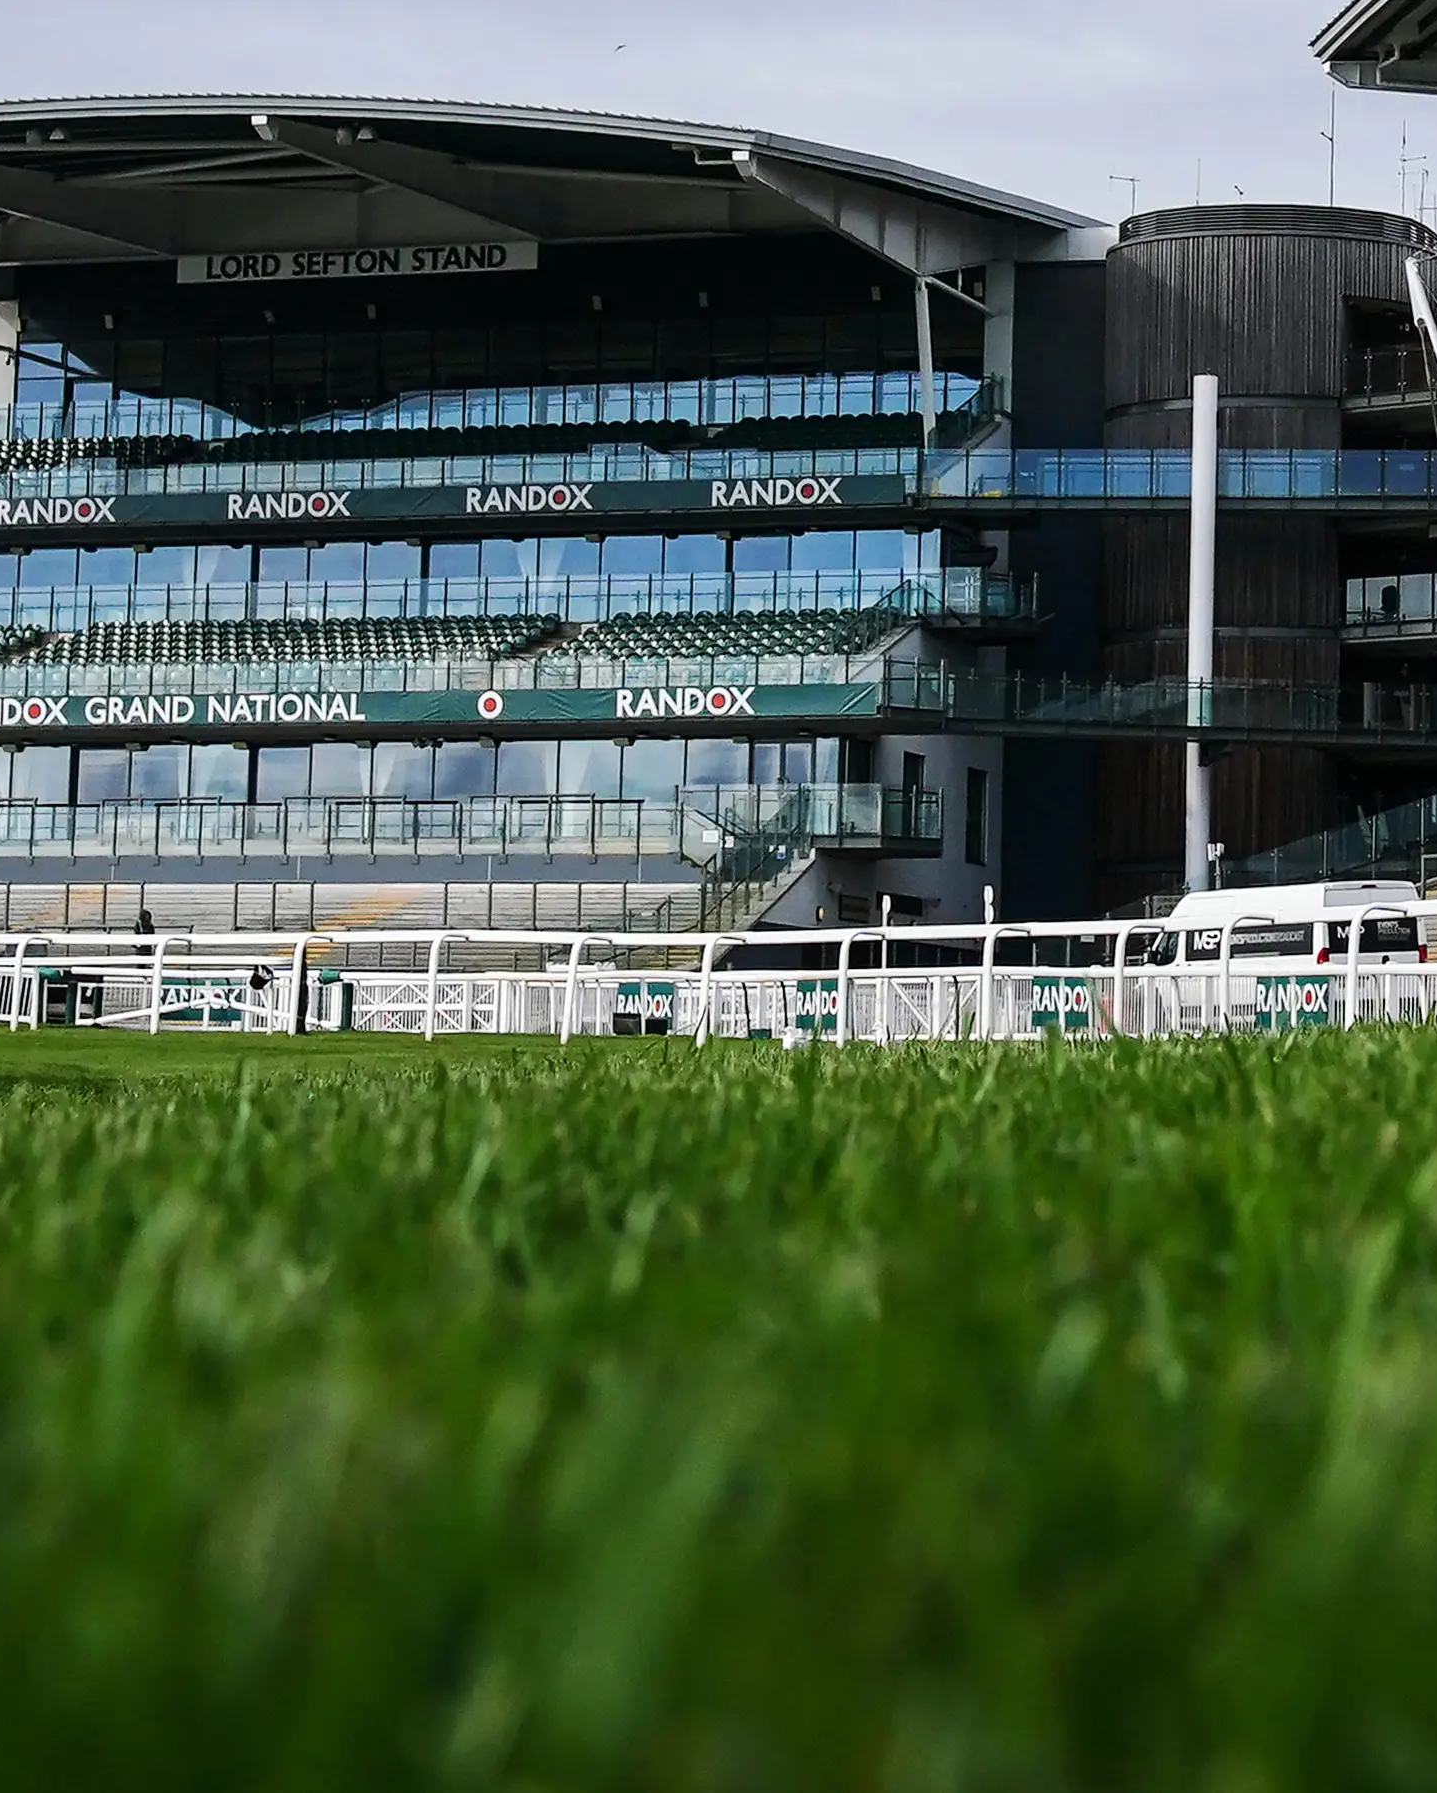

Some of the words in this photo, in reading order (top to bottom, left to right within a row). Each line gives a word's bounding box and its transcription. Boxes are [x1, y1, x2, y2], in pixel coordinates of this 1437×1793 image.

[206, 253, 281, 279] LORD
[292, 248, 400, 276] SEFTON
[411, 244, 507, 272] STAND
[228, 491, 351, 519] RANDOX
[466, 483, 593, 514] RANDOX
[711, 477, 842, 506] RANDOX
[84, 695, 194, 724] GRAND
[207, 693, 366, 723] NATIONAL
[616, 687, 756, 717] RANDOX
[797, 991, 838, 1015] RANDO
